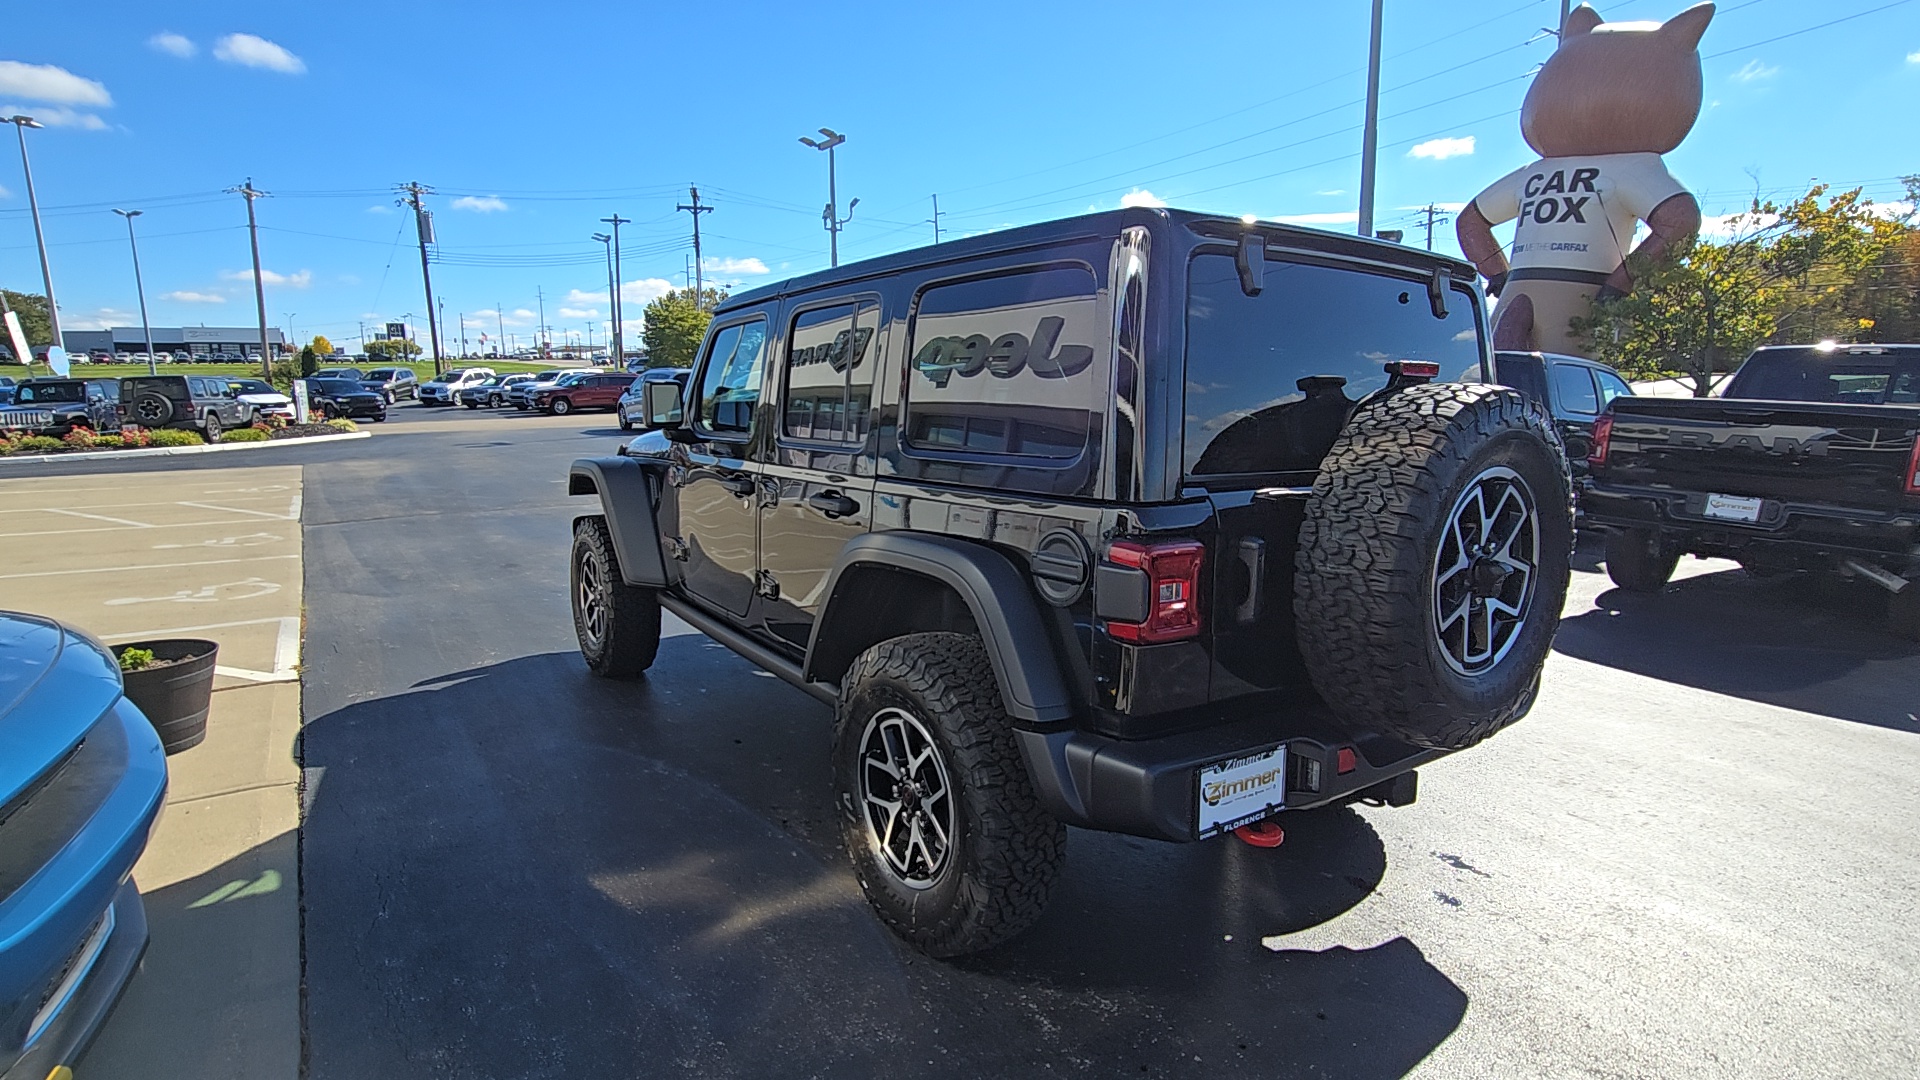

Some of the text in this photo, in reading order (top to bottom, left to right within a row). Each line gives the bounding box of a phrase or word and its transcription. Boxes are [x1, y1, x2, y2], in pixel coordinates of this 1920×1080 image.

[1524, 168, 1600, 198] CAR
[1518, 196, 1591, 228] FOX
[1550, 242, 1589, 252] CARFAX
[1667, 430, 1830, 456] RAM
[1225, 752, 1267, 772] Zimmer
[1205, 766, 1281, 804] Zimmer
[1223, 811, 1266, 833] FLORENCE
